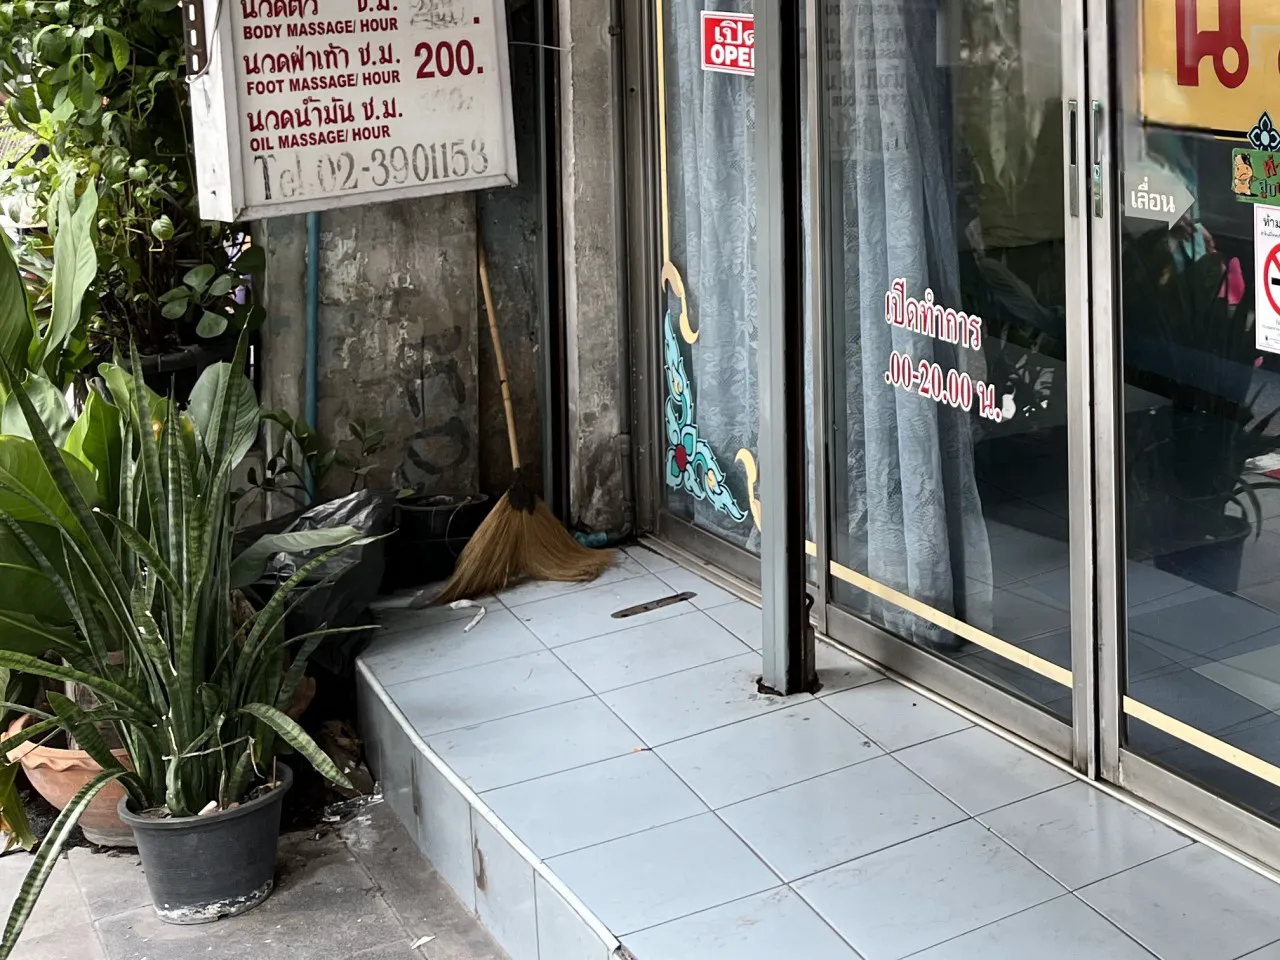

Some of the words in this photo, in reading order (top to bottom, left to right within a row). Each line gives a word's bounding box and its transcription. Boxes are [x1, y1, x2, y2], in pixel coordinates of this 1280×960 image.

[243, 24, 282, 40] BODY
[286, 19, 357, 37] MASSAGE/
[360, 17, 399, 33] HOUR
[243, 42, 350, 76] นวดฝ่าเท้า
[358, 41, 401, 67] ช.ม.
[246, 79, 285, 96] FOOT
[289, 73, 359, 92] MASSAGE/
[362, 70, 401, 86] HOUR
[247, 96, 355, 132] นวดน้ำมัน
[362, 96, 403, 122] ช.ม.
[249, 137, 274, 153] OIL
[278, 128, 349, 149] MASSAGE/
[352, 124, 391, 141] HOUR
[1131, 176, 1176, 214] เลื่อน
[884, 277, 982, 351] เปิดทำการ
[976, 380, 1002, 423] น.
